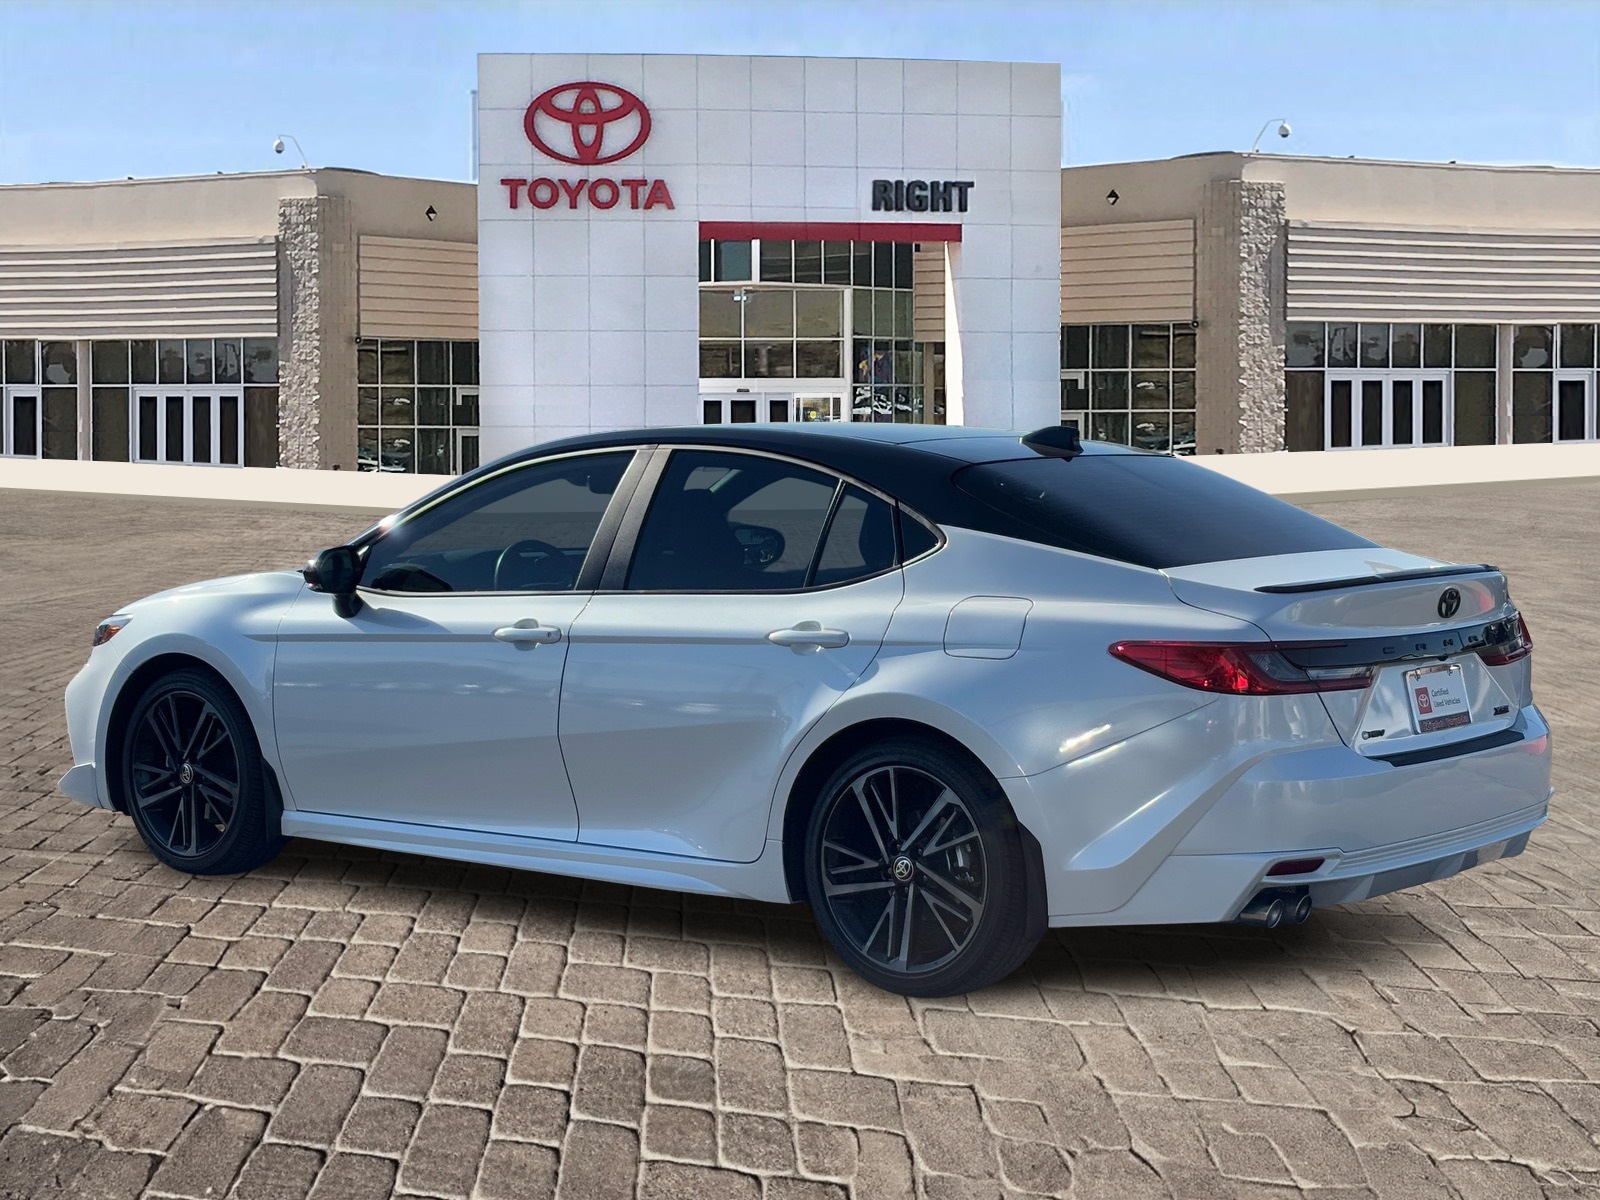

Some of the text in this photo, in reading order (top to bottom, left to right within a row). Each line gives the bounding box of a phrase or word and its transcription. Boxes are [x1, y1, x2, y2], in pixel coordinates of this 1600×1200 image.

[500, 178, 675, 210] TOYOTA
[872, 180, 975, 212] RIGHT
[1431, 688, 1449, 697] Certified
[1433, 699, 1445, 708] Used
